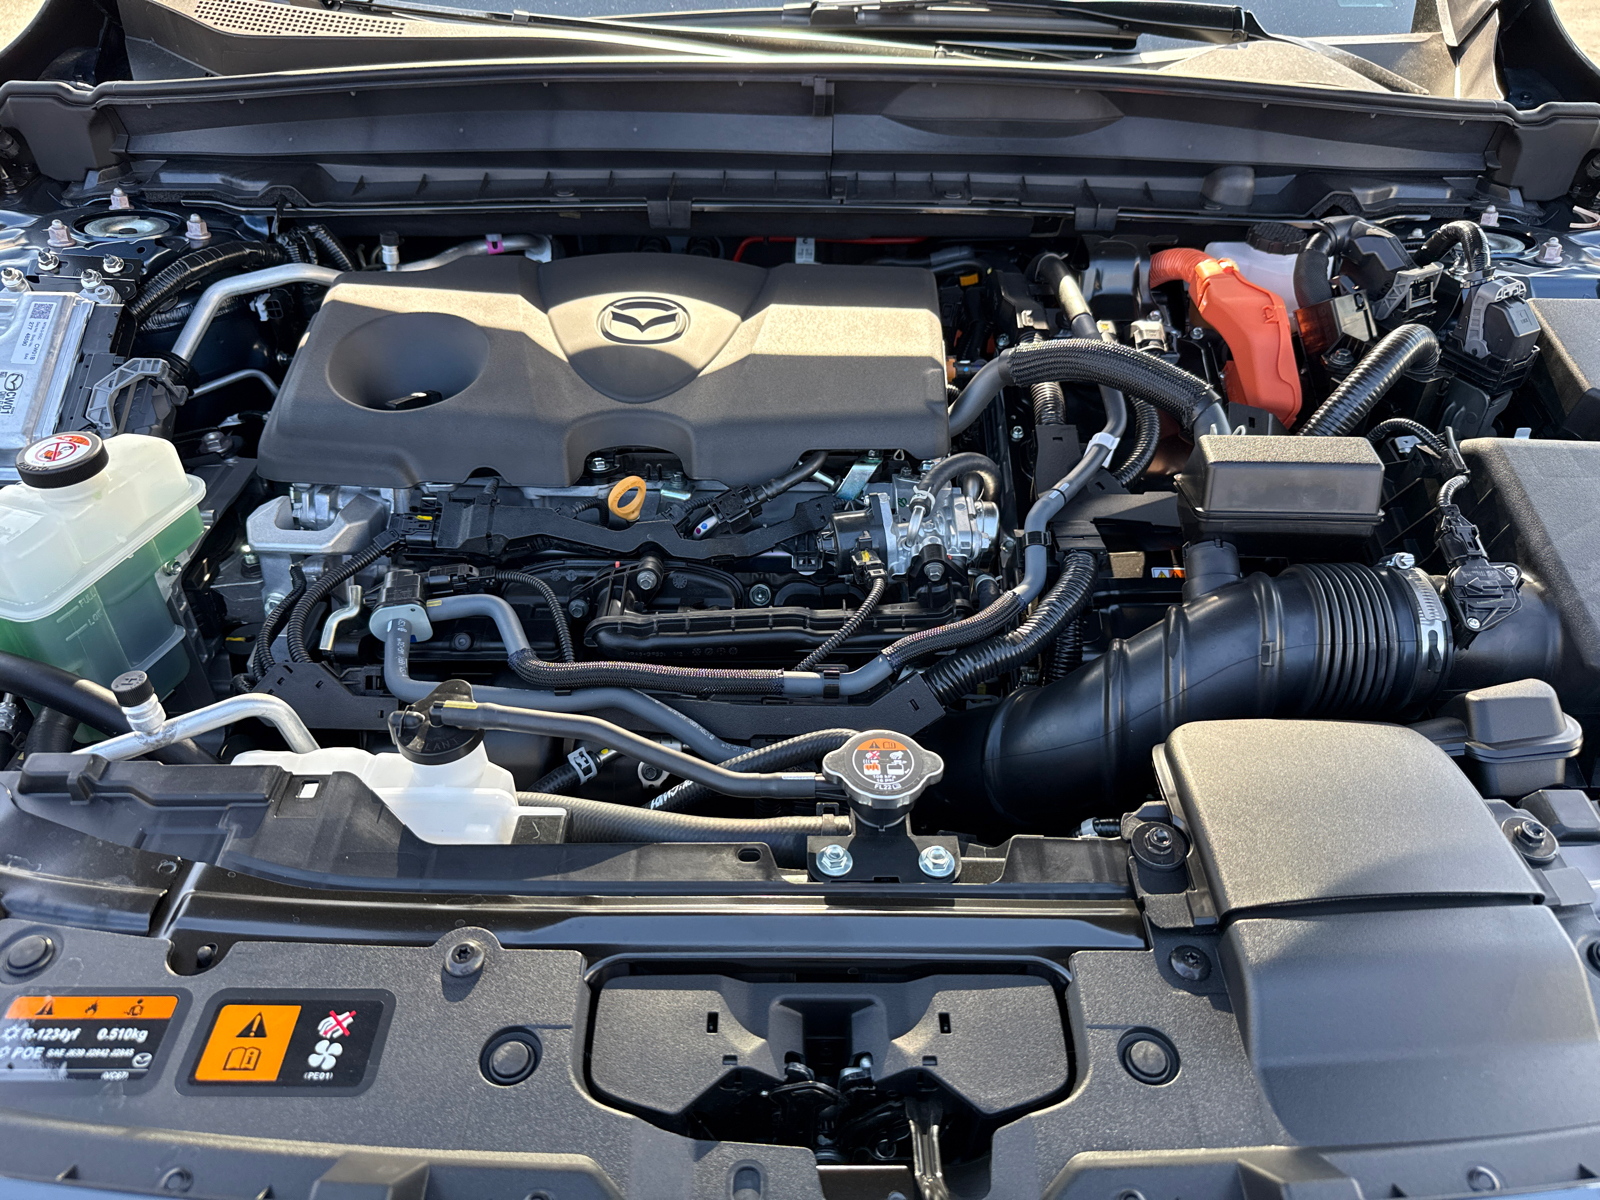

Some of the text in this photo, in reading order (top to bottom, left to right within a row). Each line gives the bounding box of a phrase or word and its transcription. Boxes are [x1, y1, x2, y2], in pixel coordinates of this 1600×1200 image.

[1, 391, 17, 414] CW01
[20, 1027, 148, 1043] R-1234yf 0.510kg
[11, 1046, 45, 1058] POE
[303, 1071, 334, 1081] (PE01)
